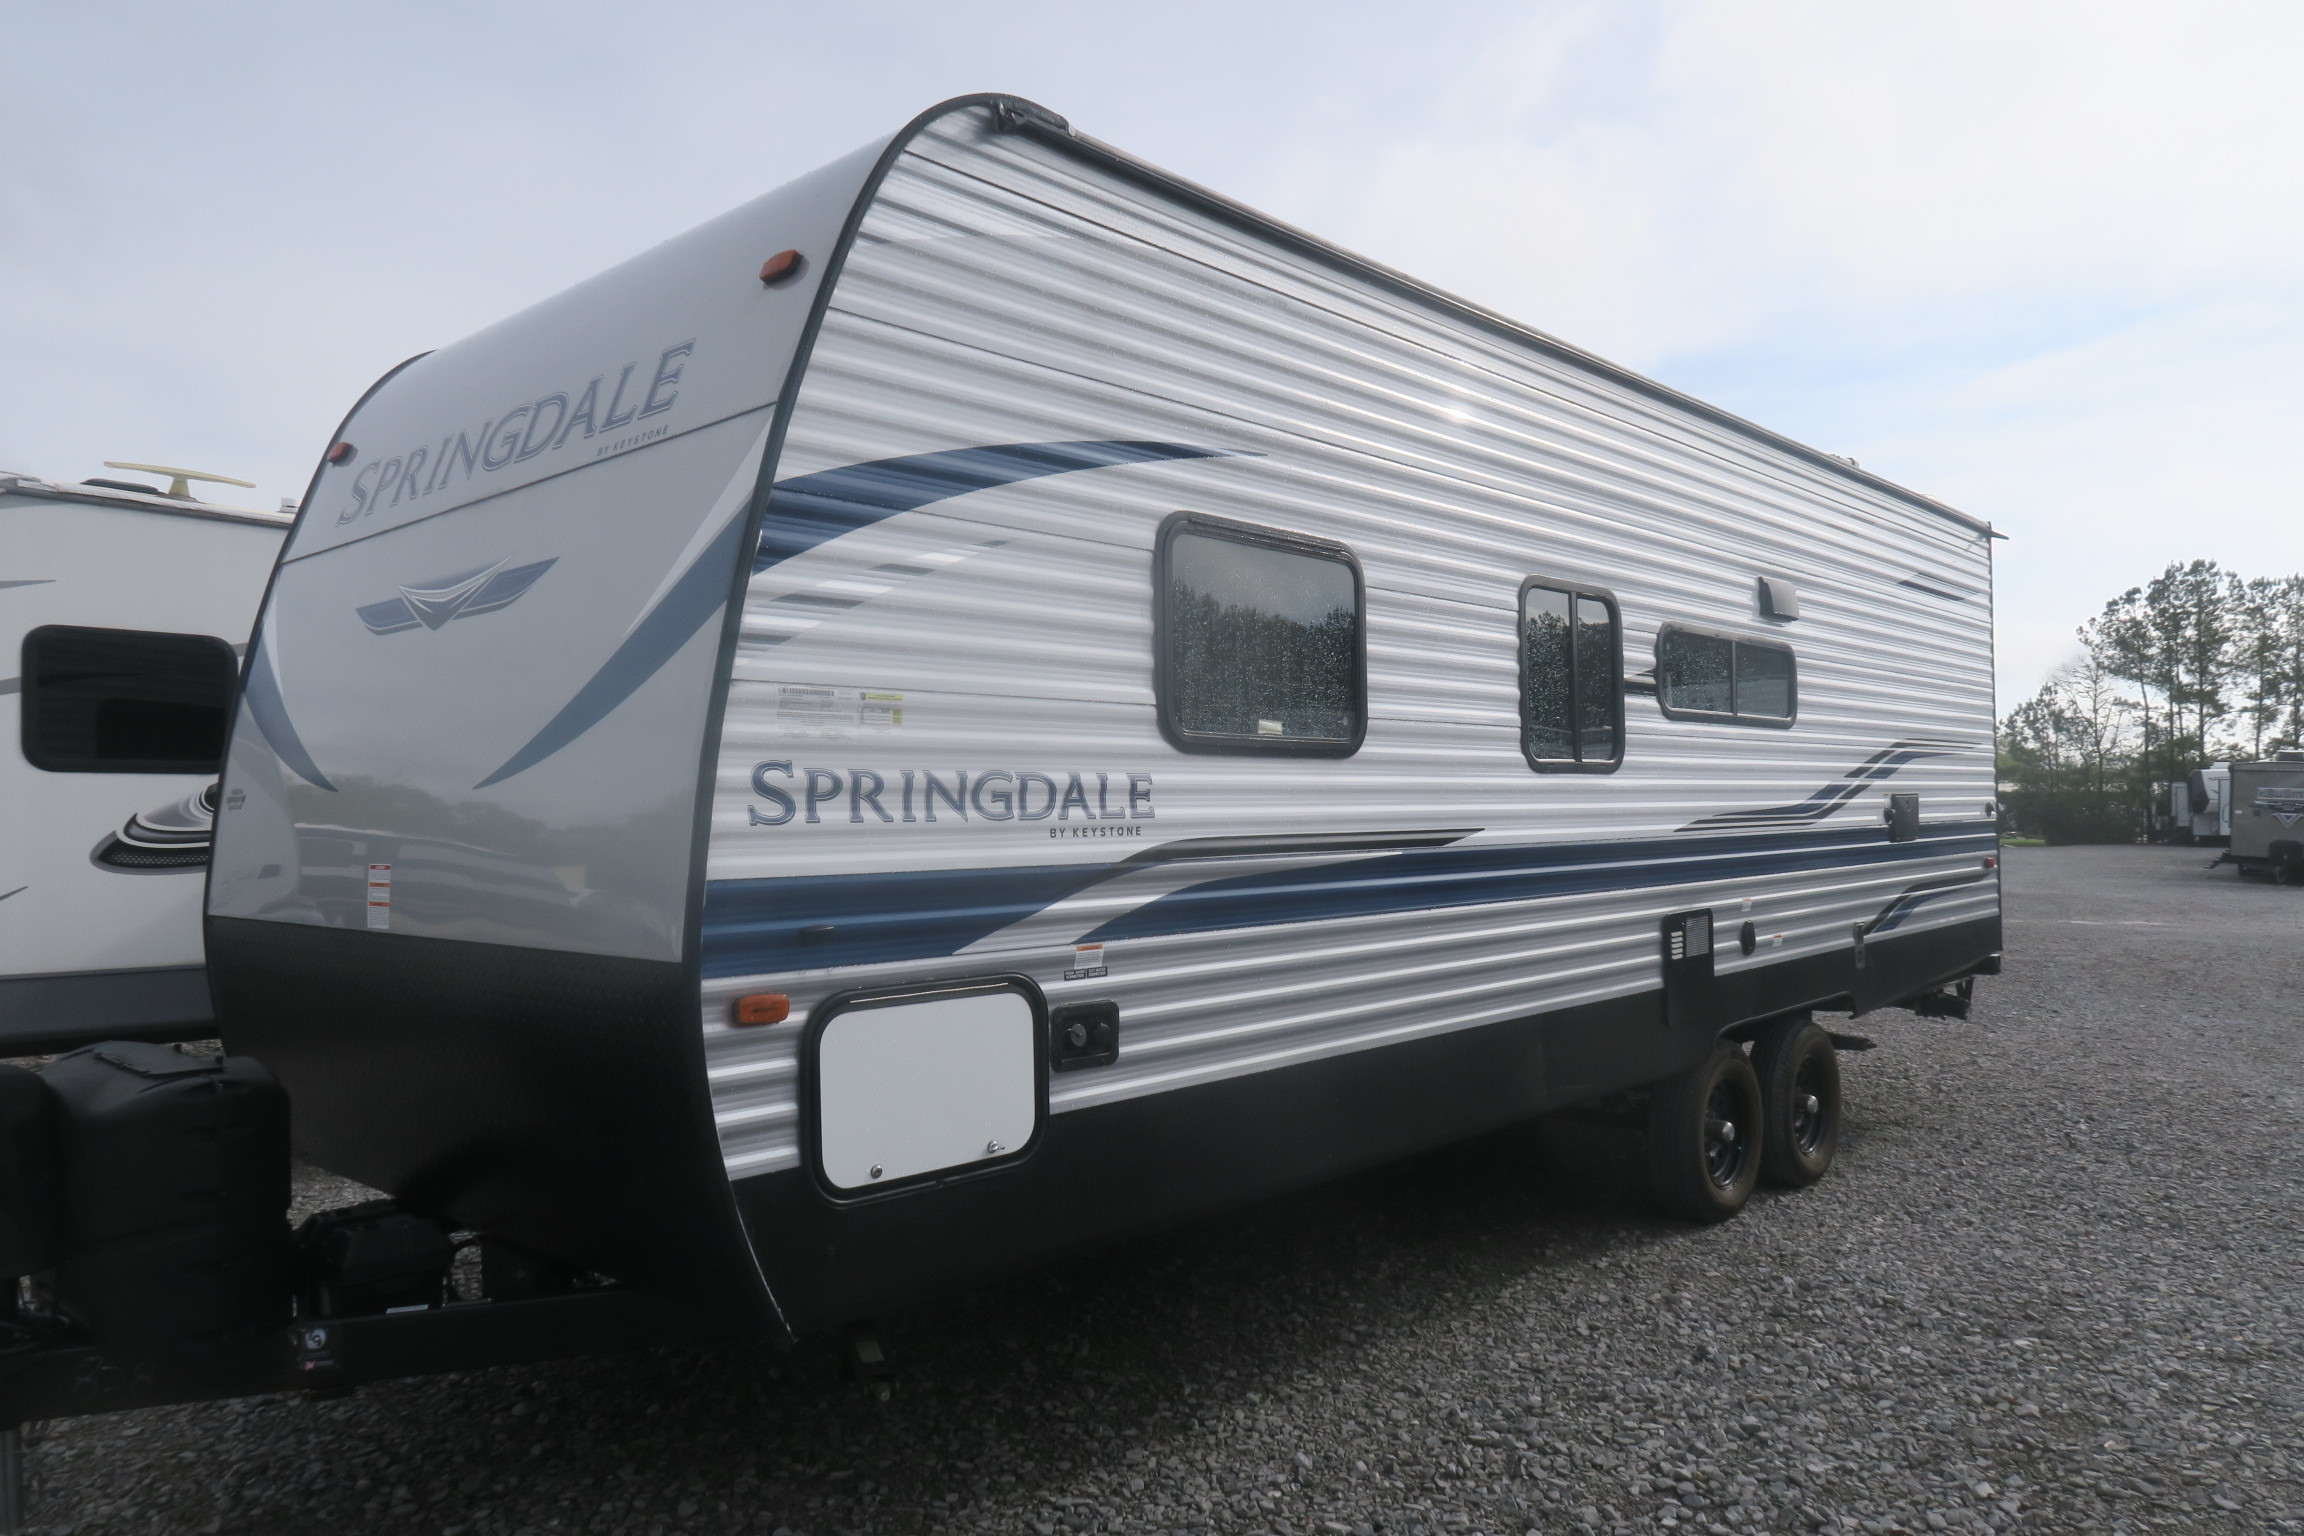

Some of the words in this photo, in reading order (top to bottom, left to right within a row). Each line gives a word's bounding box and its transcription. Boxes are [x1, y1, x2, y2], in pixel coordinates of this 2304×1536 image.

[336, 338, 696, 527] SPRINGDALE
[597, 445, 610, 457] BY
[613, 425, 669, 451] KEYSTONE
[747, 759, 1156, 827] SPRINGDALE
[1050, 828, 1066, 839] BY
[1072, 826, 1142, 838] KEYSTONE
